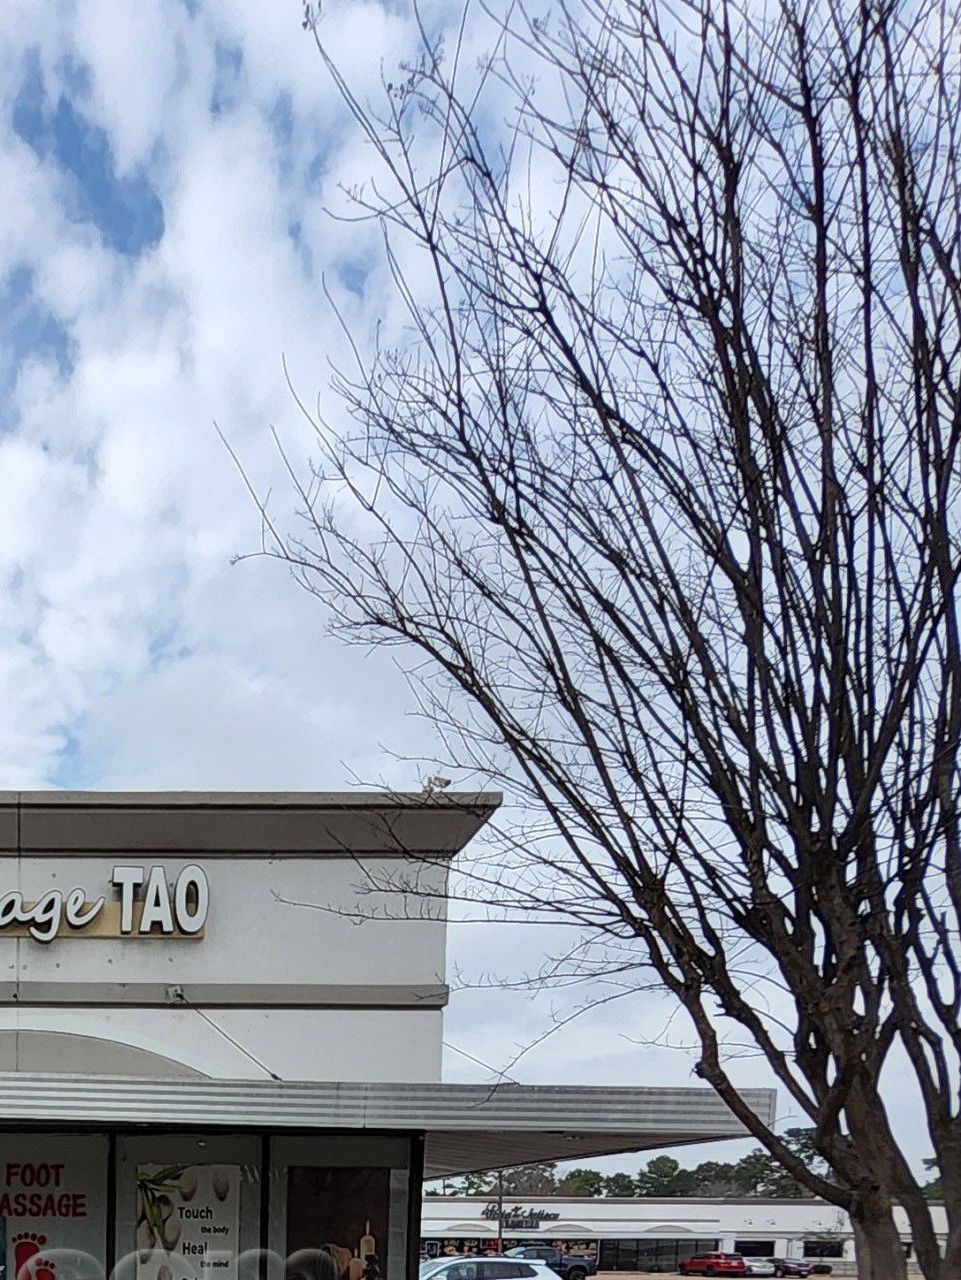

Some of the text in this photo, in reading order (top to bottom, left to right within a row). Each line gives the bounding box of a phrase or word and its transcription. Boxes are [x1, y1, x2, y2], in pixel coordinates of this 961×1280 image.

[111, 864, 210, 936] TAO
[5, 1162, 65, 1187] FOOT
[178, 1206, 213, 1219] Touch
[200, 1225, 229, 1235] the body
[182, 1241, 207, 1255] Heal
[212, 1259, 229, 1268] mind
